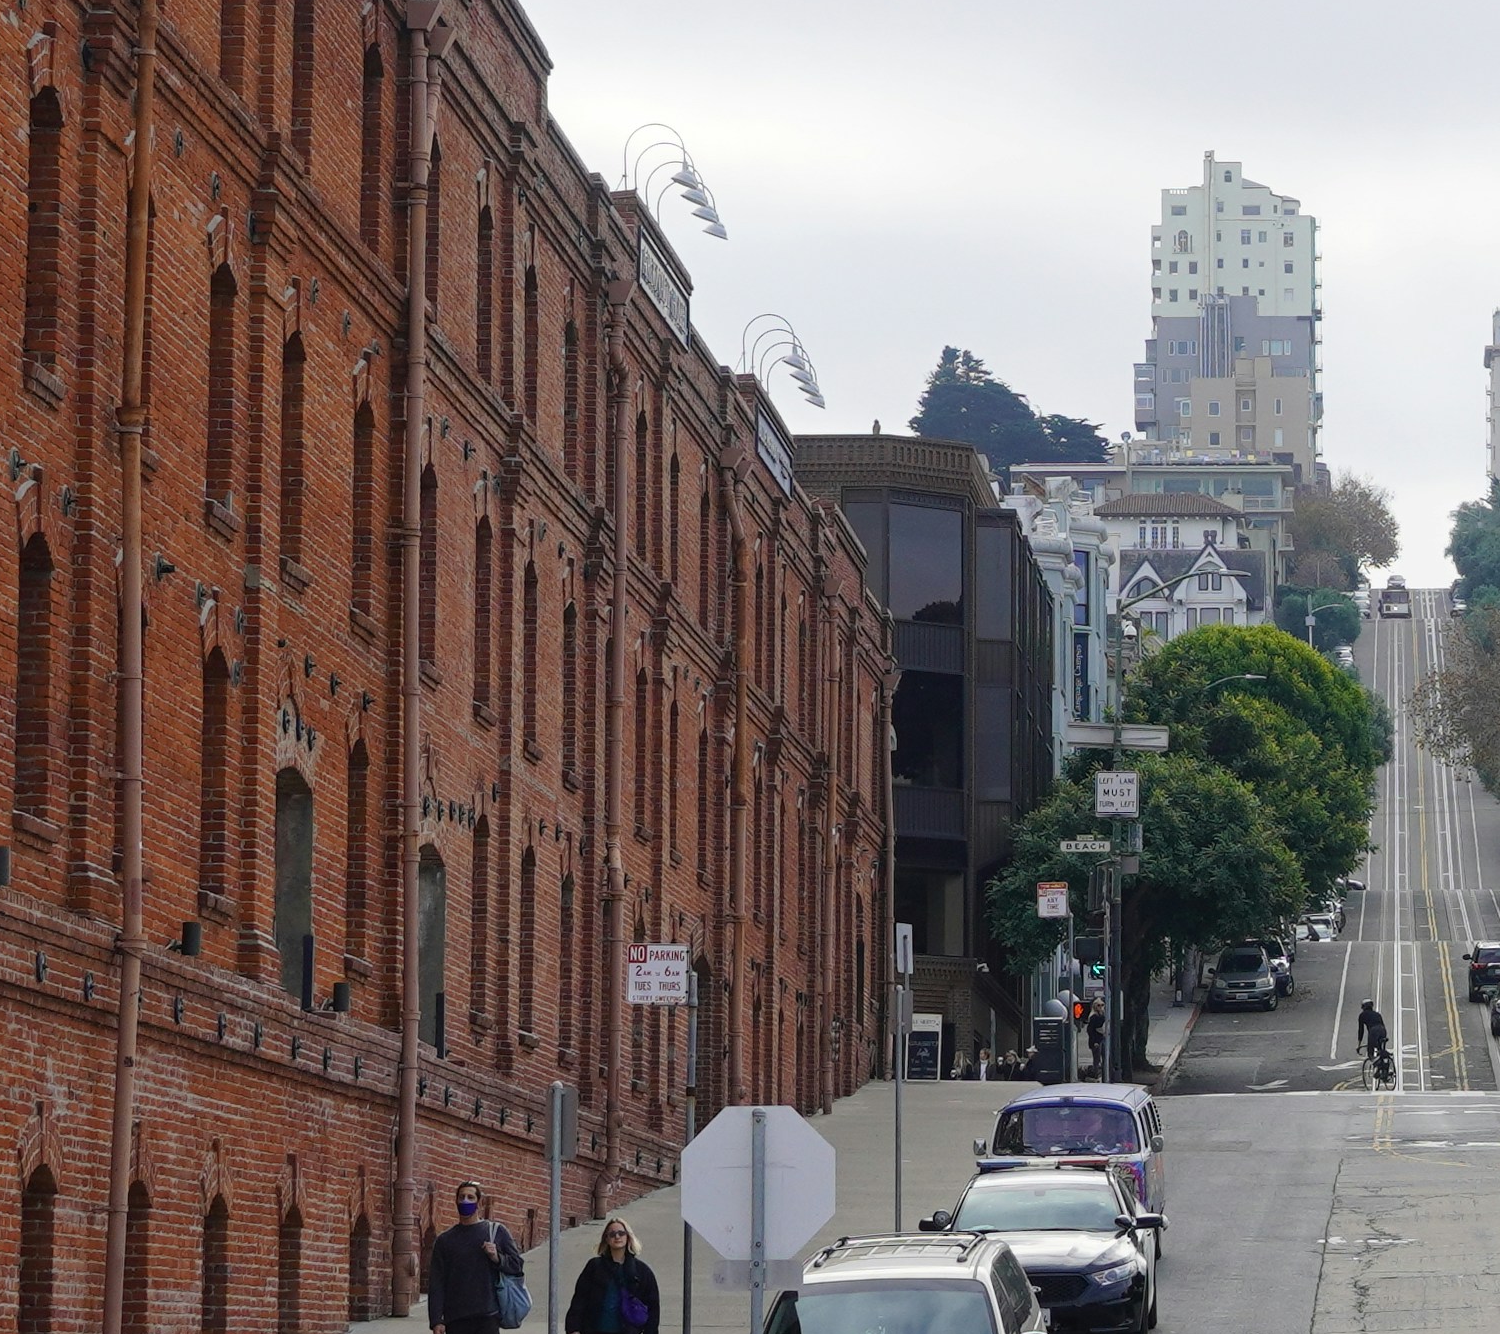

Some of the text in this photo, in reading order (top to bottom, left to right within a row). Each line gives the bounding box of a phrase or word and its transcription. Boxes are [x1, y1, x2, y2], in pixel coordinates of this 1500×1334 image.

[1099, 777, 1136, 785] LEFT LANE
[1103, 788, 1132, 797] MUST
[1065, 842, 1106, 850] BEACH
[630, 946, 685, 962] NO PARKING
[634, 981, 681, 992] TUES THURS
